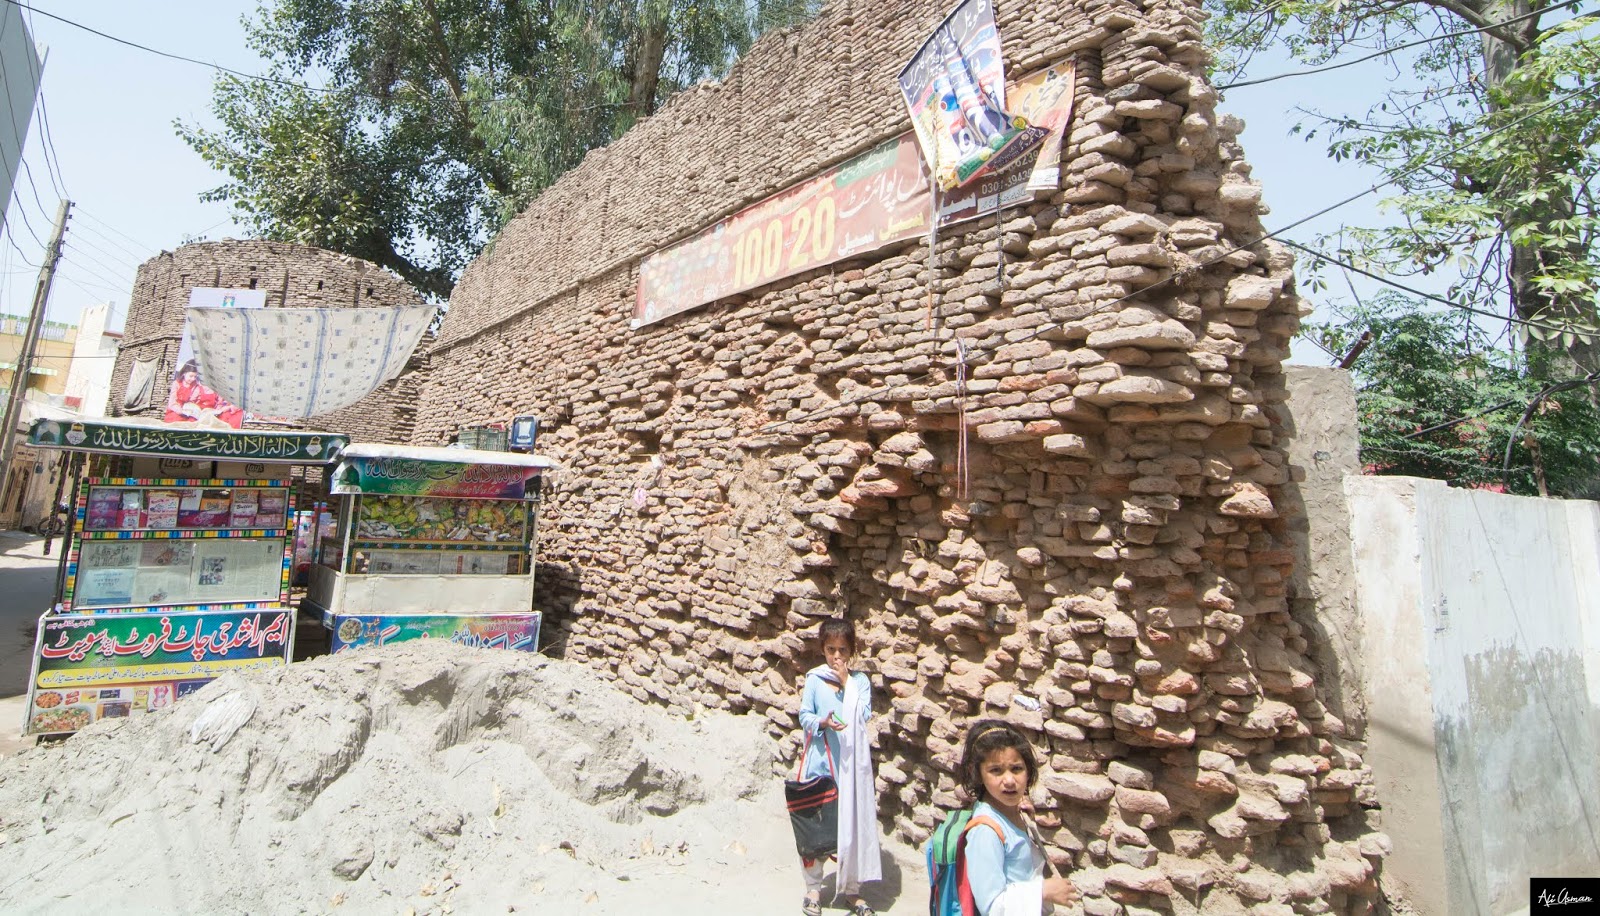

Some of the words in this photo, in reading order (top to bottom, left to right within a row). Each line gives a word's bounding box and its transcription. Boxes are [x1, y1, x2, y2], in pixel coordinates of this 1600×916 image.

[732, 218, 783, 289] 100
[788, 196, 836, 269] 20
[114, 617, 173, 657] فروٹ
[162, 618, 211, 661] چاٹ
[209, 622, 233, 655] جی
[226, 613, 261, 649] راشد
[258, 613, 289, 656] ایم
